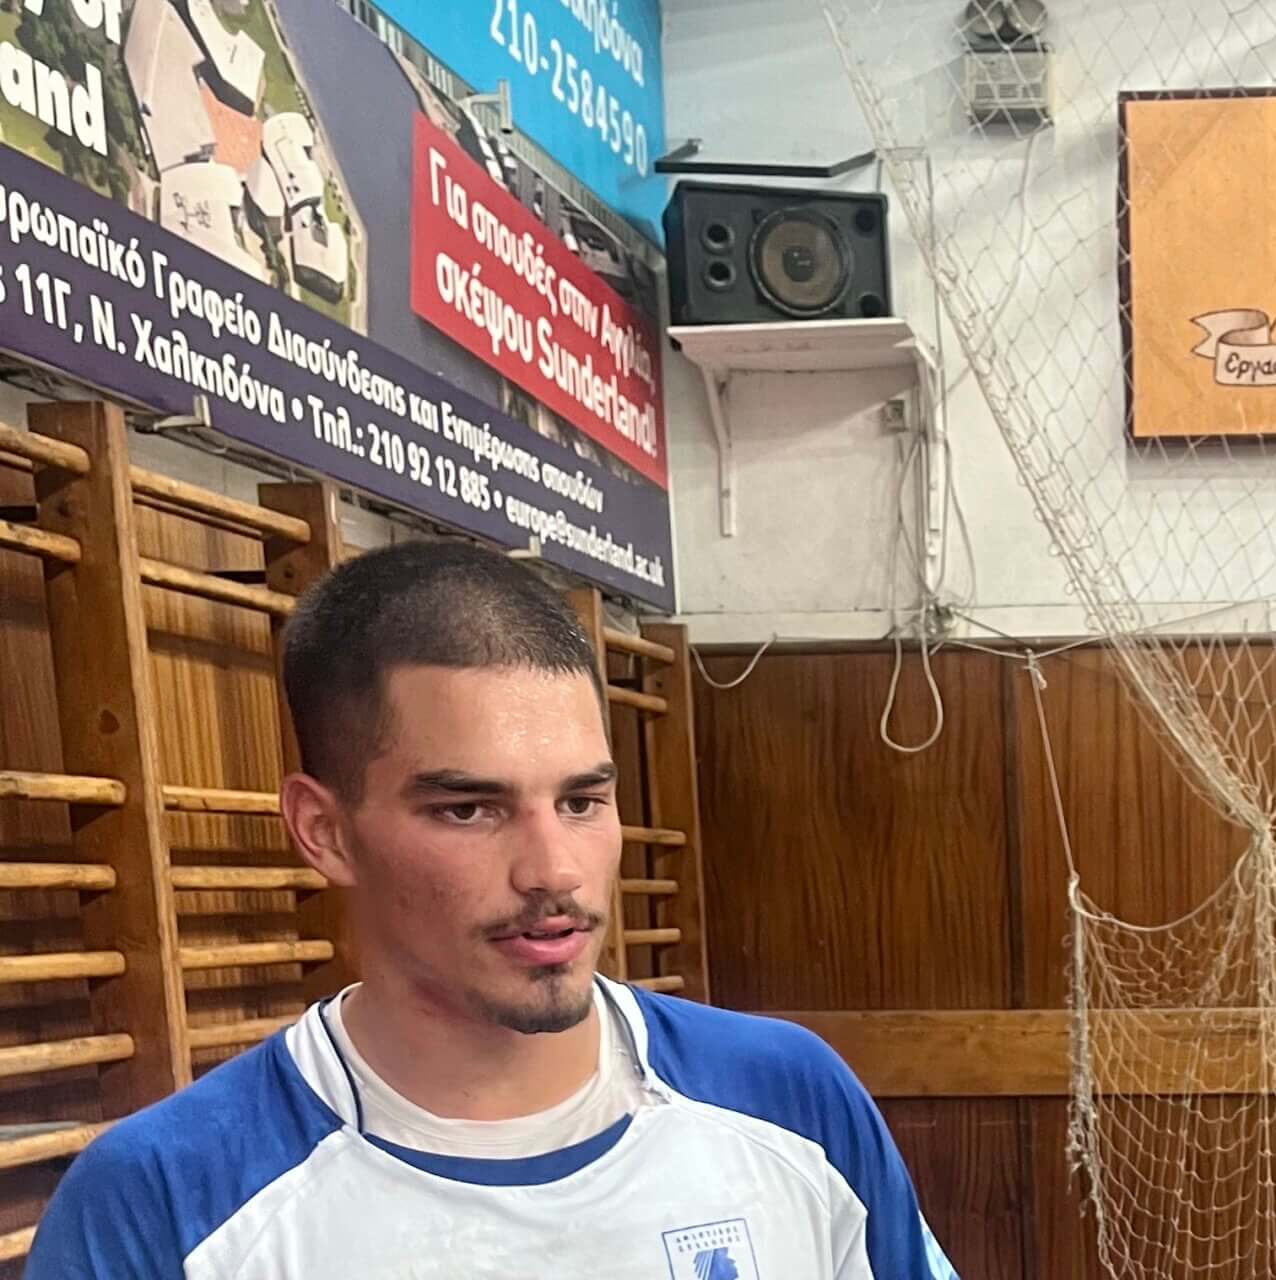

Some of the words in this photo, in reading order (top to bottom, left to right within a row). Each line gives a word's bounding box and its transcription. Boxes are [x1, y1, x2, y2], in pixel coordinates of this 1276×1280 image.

[0, 184, 146, 288] ρωπαϊκό
[152, 250, 261, 345] Γραφείο
[268, 311, 407, 417] Διασύνδεσης
[409, 392, 439, 433] και
[441, 401, 540, 482] Ενημέρωσης
[429, 147, 469, 230] Για
[471, 201, 557, 316] σπουδές
[559, 278, 598, 338] στην
[130, 311, 287, 424] Χαλκηδόνα
[367, 422, 406, 475] 210
[407, 441, 433, 487] 92
[434, 455, 459, 498] 12
[459, 465, 491, 511] 885
[435, 252, 532, 363] σκέψου
[537, 317, 658, 458] Sunderland!
